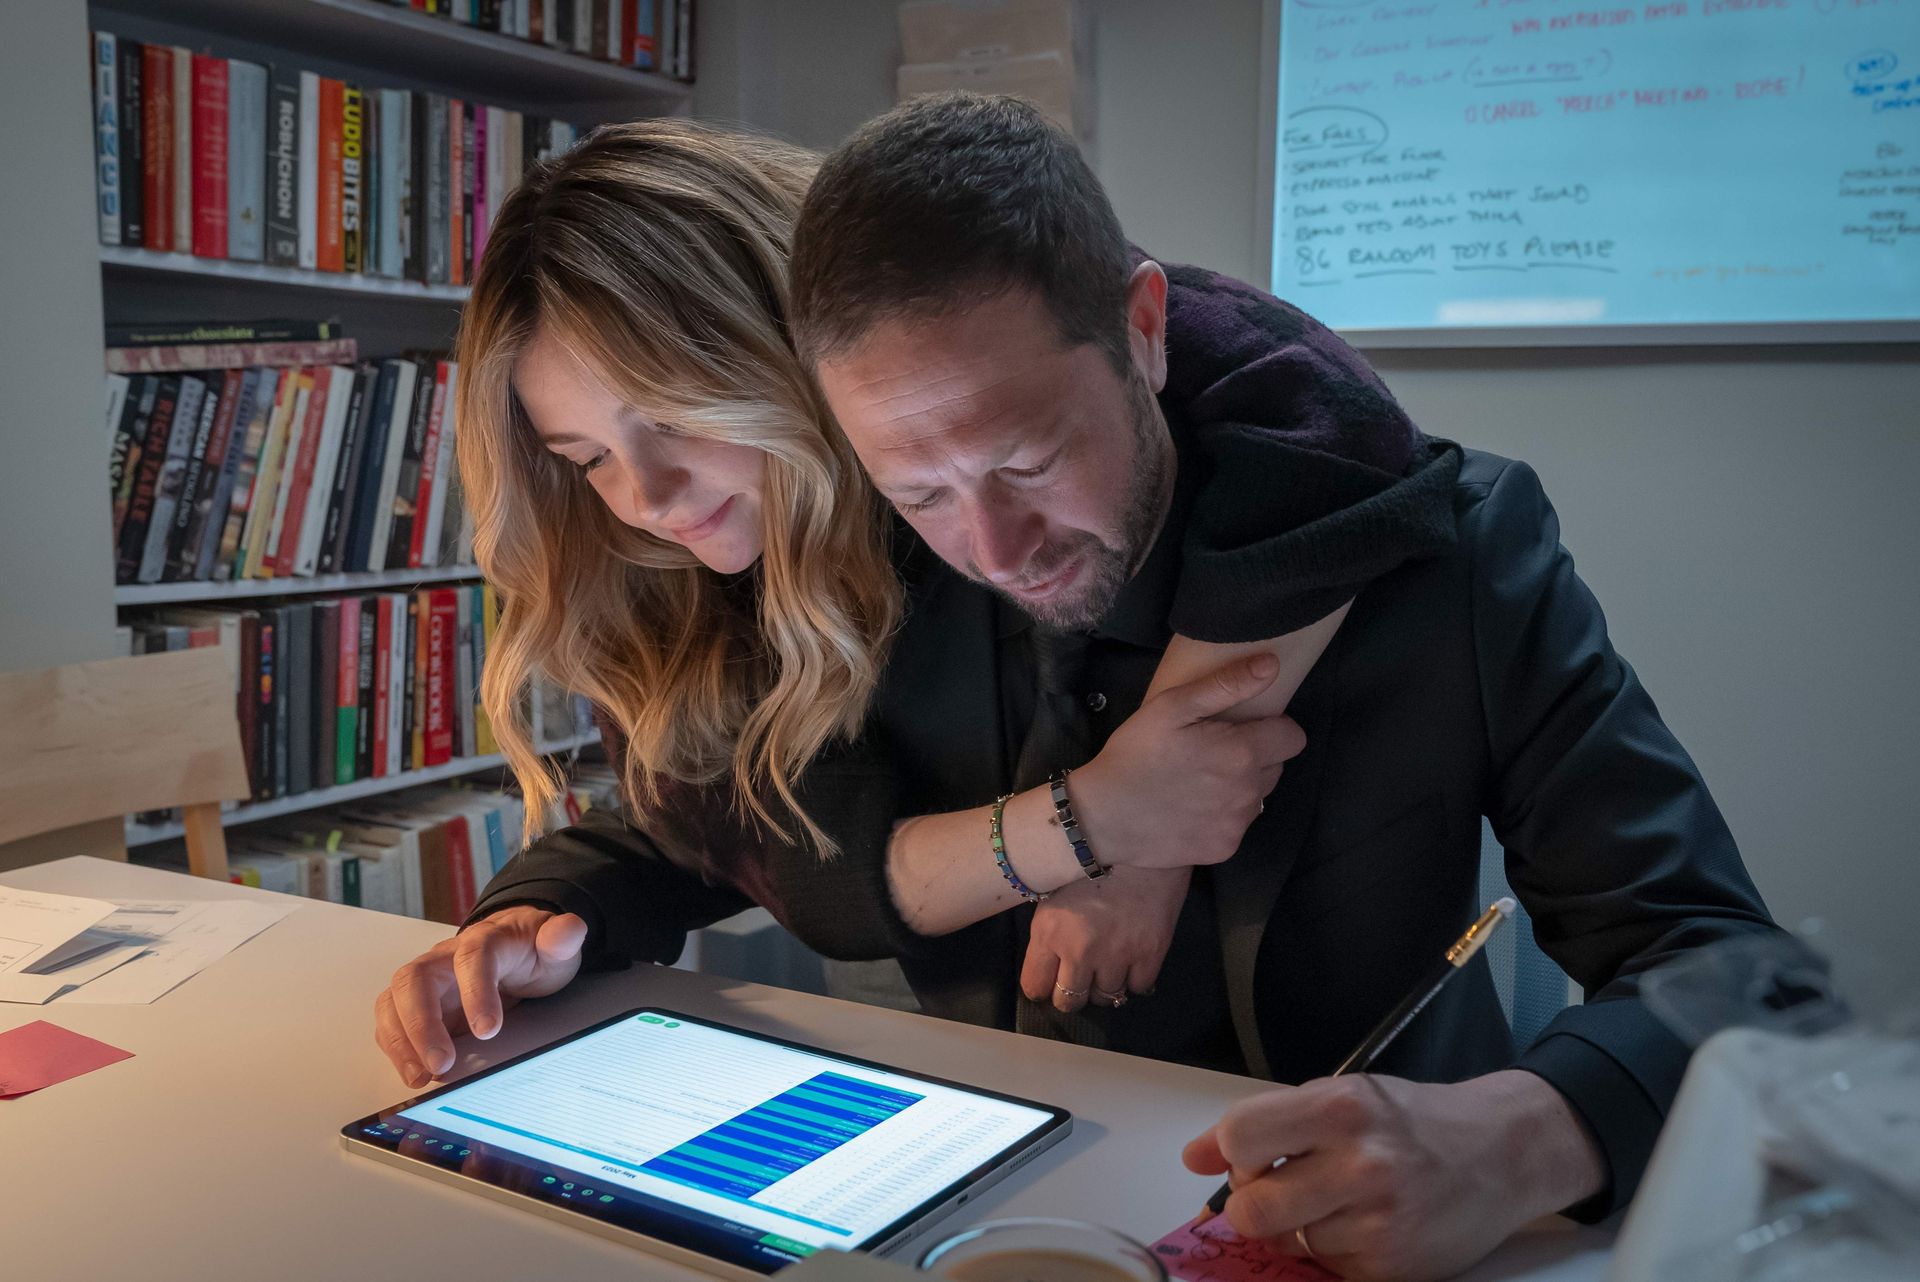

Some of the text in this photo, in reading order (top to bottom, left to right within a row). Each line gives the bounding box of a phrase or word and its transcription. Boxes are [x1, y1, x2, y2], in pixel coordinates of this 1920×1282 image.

[279, 98, 293, 220] ROBUCHON
[343, 87, 362, 233] LUDOBITES
[1296, 235, 1616, 275] 86 RANDOM TOYS PLEASE
[193, 391, 217, 460] AMERICAN
[429, 615, 443, 732] COOKBOOK
